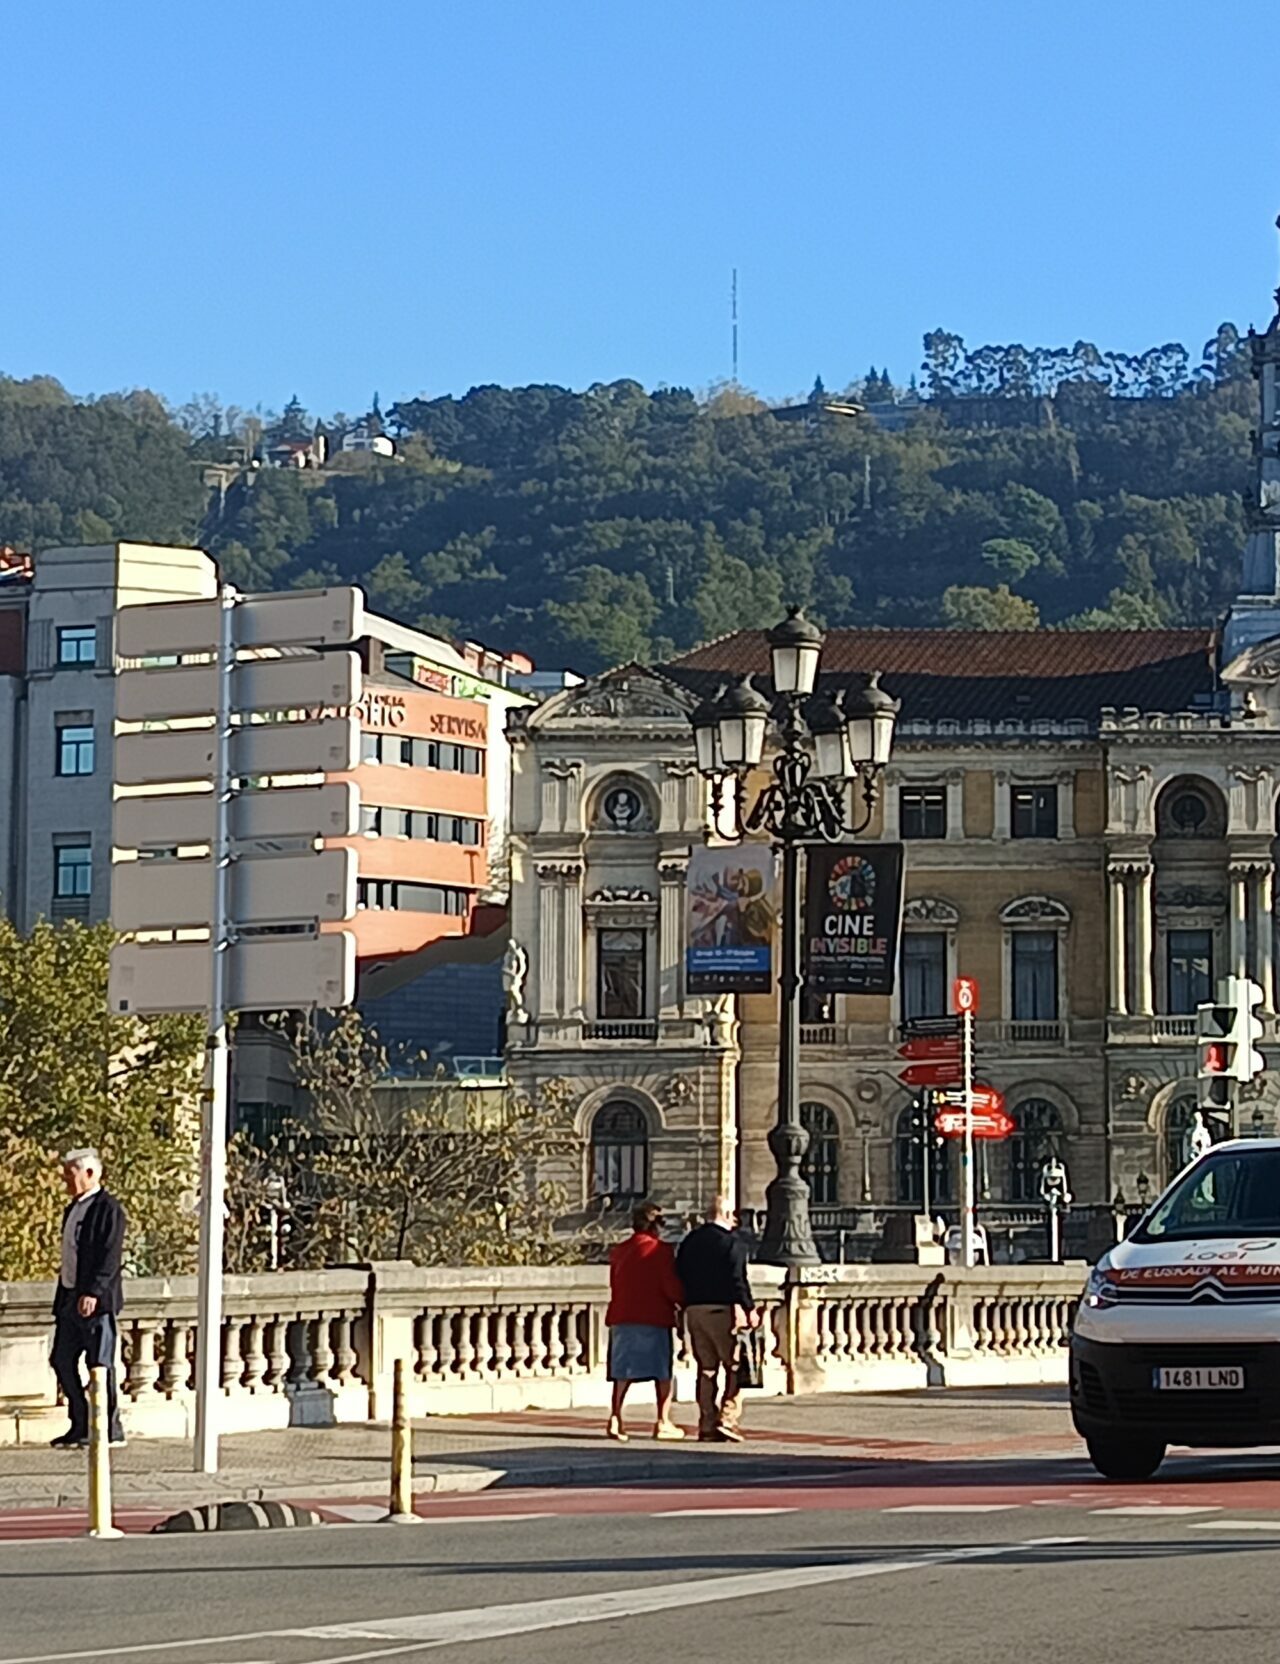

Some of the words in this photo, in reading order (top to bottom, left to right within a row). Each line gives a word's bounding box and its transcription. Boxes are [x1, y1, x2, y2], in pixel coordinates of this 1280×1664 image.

[824, 914, 874, 936] CINE
[809, 937, 888, 955] INVISIBLE
[1120, 1268, 1139, 1280] DE
[1144, 1266, 1211, 1278] EUSKADI
[1216, 1265, 1238, 1276] AL
[1164, 1370, 1200, 1387] 1481
[1207, 1370, 1240, 1387] LND
